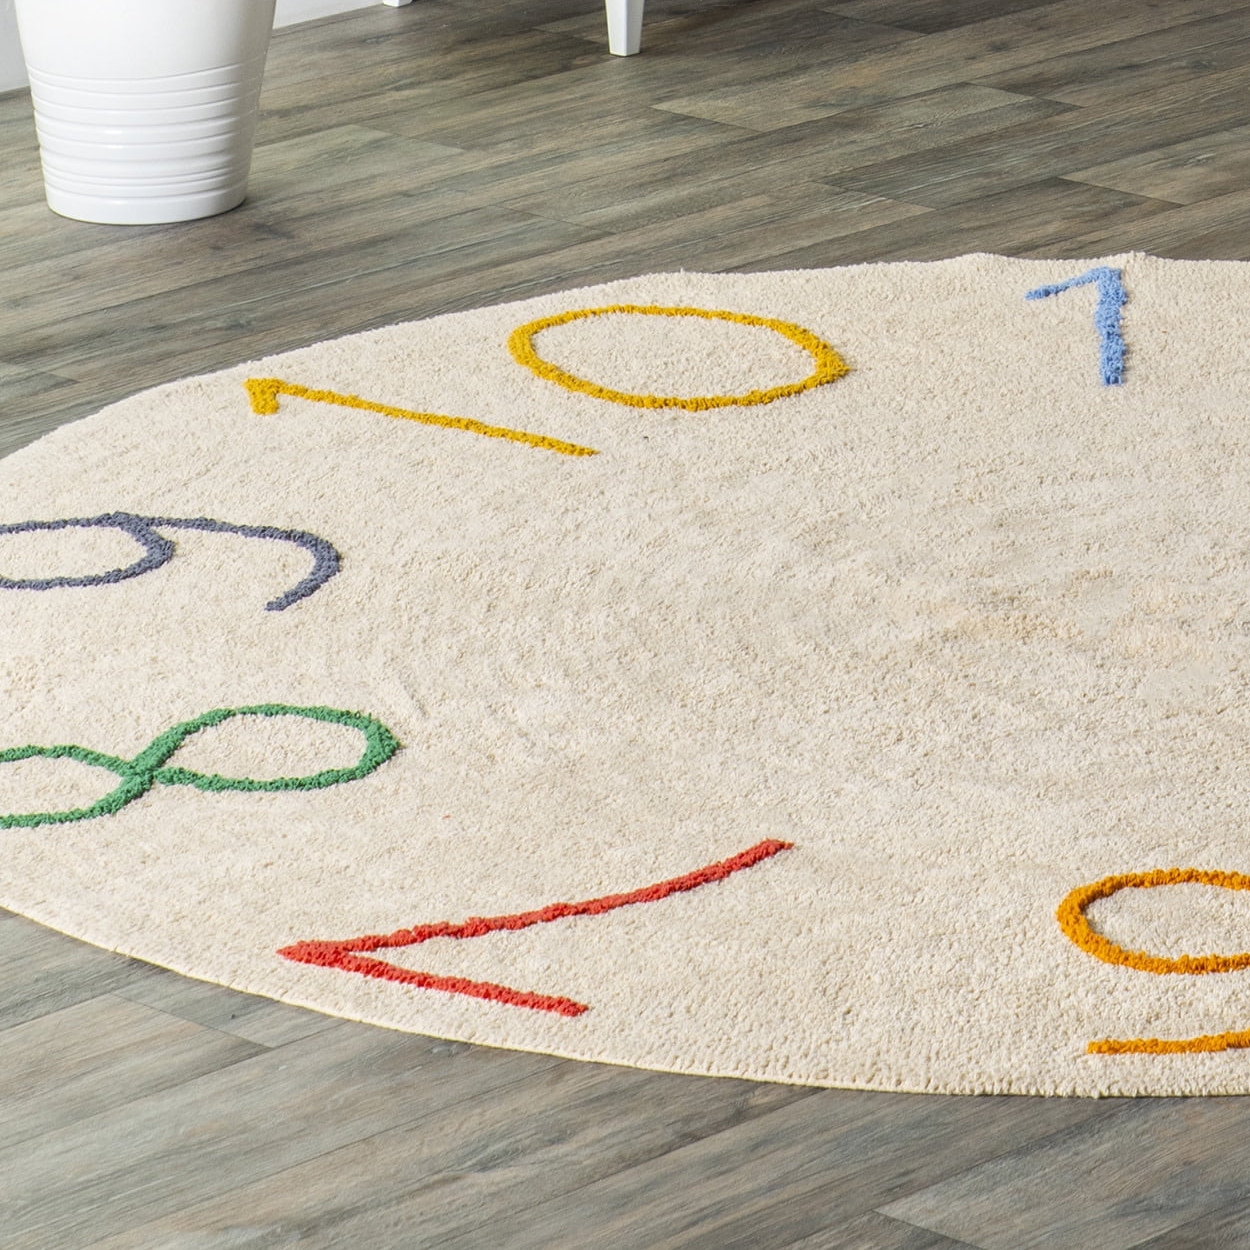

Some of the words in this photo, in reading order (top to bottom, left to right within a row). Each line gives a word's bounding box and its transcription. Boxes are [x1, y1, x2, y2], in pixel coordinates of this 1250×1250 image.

[245, 305, 850, 456] 10
[1026, 267, 1127, 386] 1
[0, 705, 399, 827] 8
[277, 839, 793, 1017] 7
